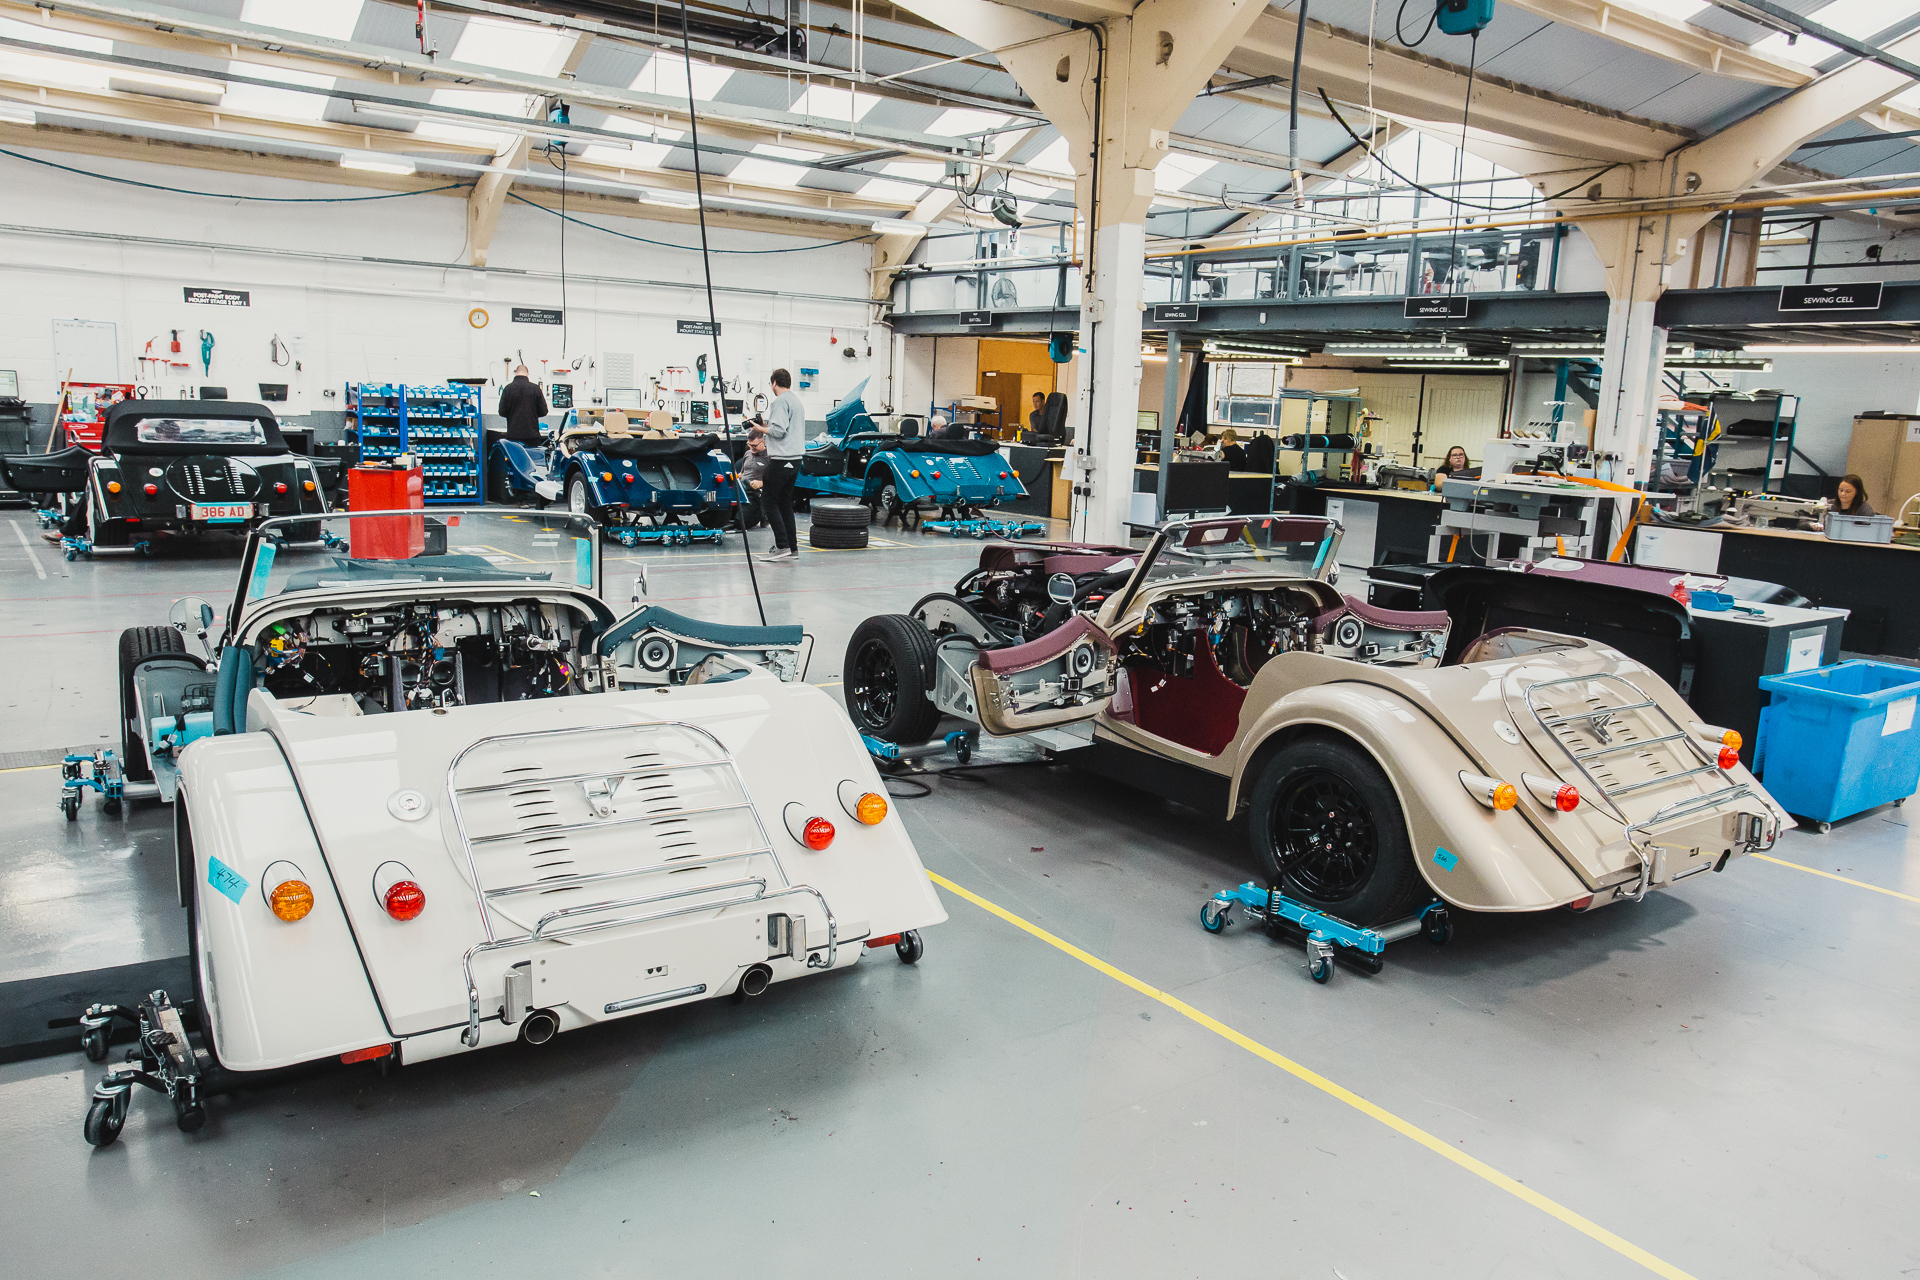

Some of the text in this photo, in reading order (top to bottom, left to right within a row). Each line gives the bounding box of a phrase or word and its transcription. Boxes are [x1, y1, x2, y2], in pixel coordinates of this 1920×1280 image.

[202, 507, 245, 517] 386 AD
[217, 867, 240, 890] 474
